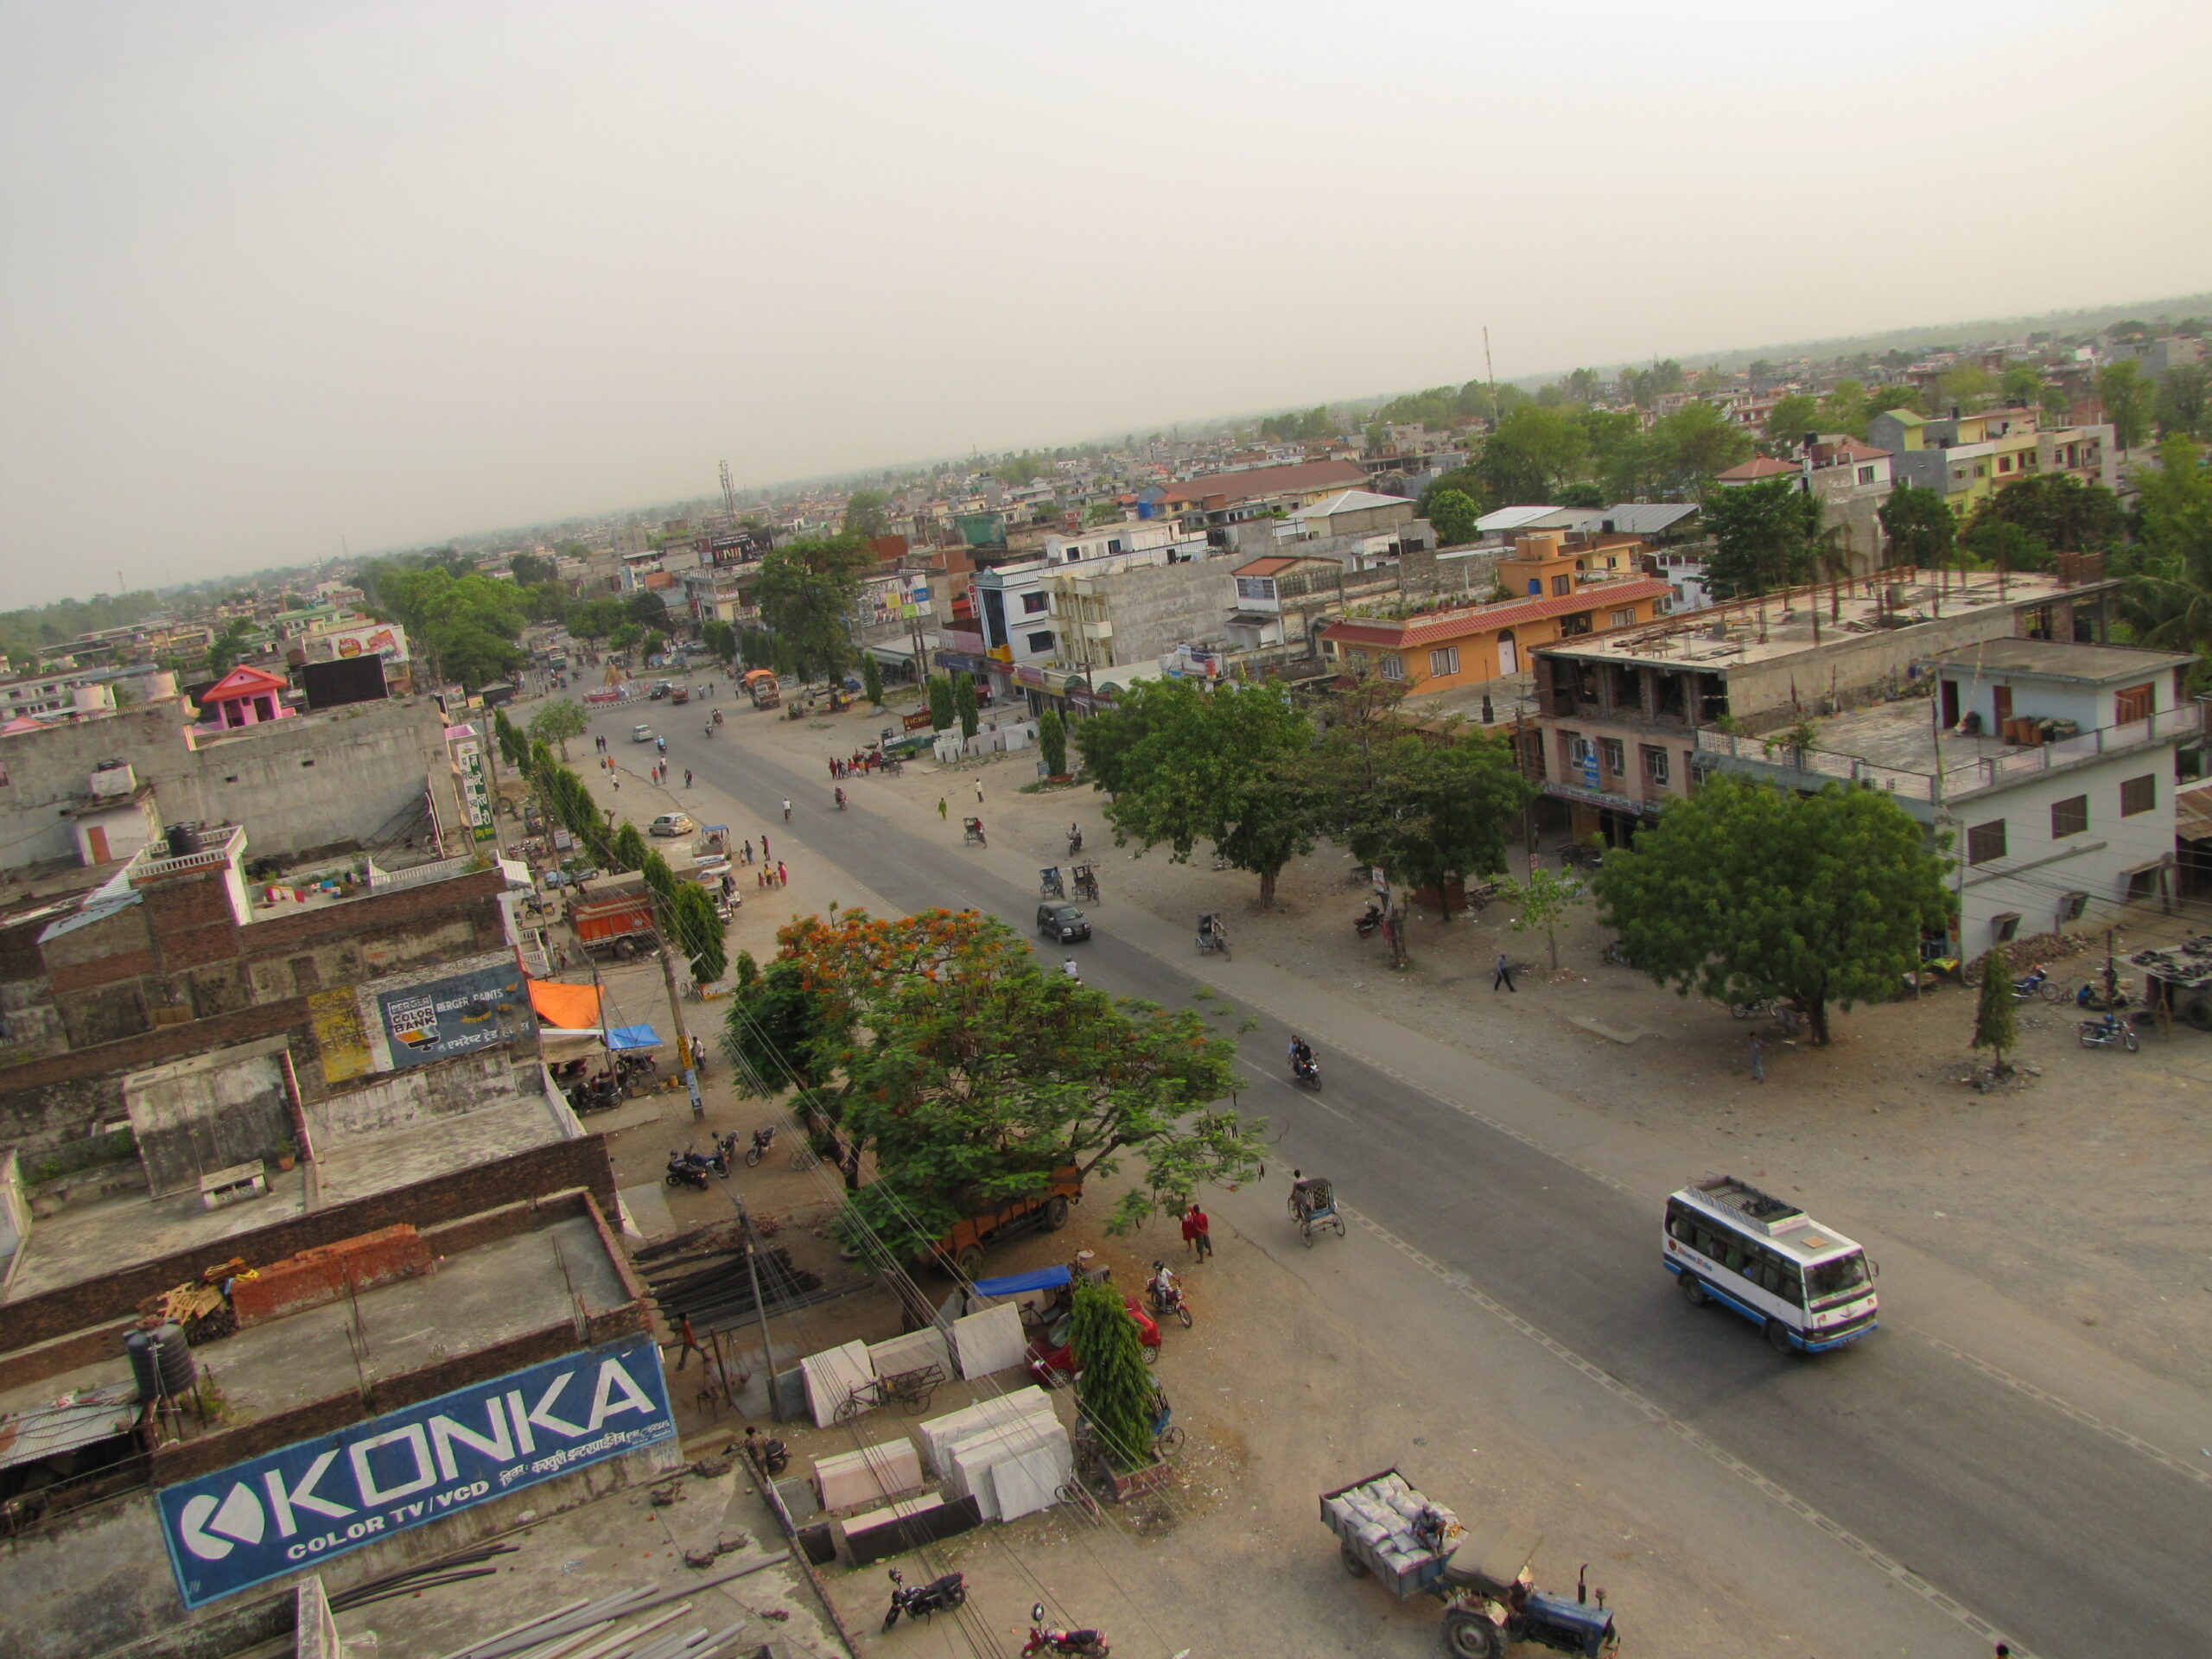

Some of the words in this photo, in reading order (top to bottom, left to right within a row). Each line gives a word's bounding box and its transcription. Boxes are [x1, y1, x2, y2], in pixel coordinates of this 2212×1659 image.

[391, 997, 429, 1014] BERGER
[436, 997, 469, 1013] BERGER
[474, 988, 504, 1001] PAINTS
[392, 1007, 433, 1024] COLOR
[394, 1016, 435, 1033] BANK
[264, 1357, 657, 1537] KONKA
[287, 1515, 385, 1560] COLOR
